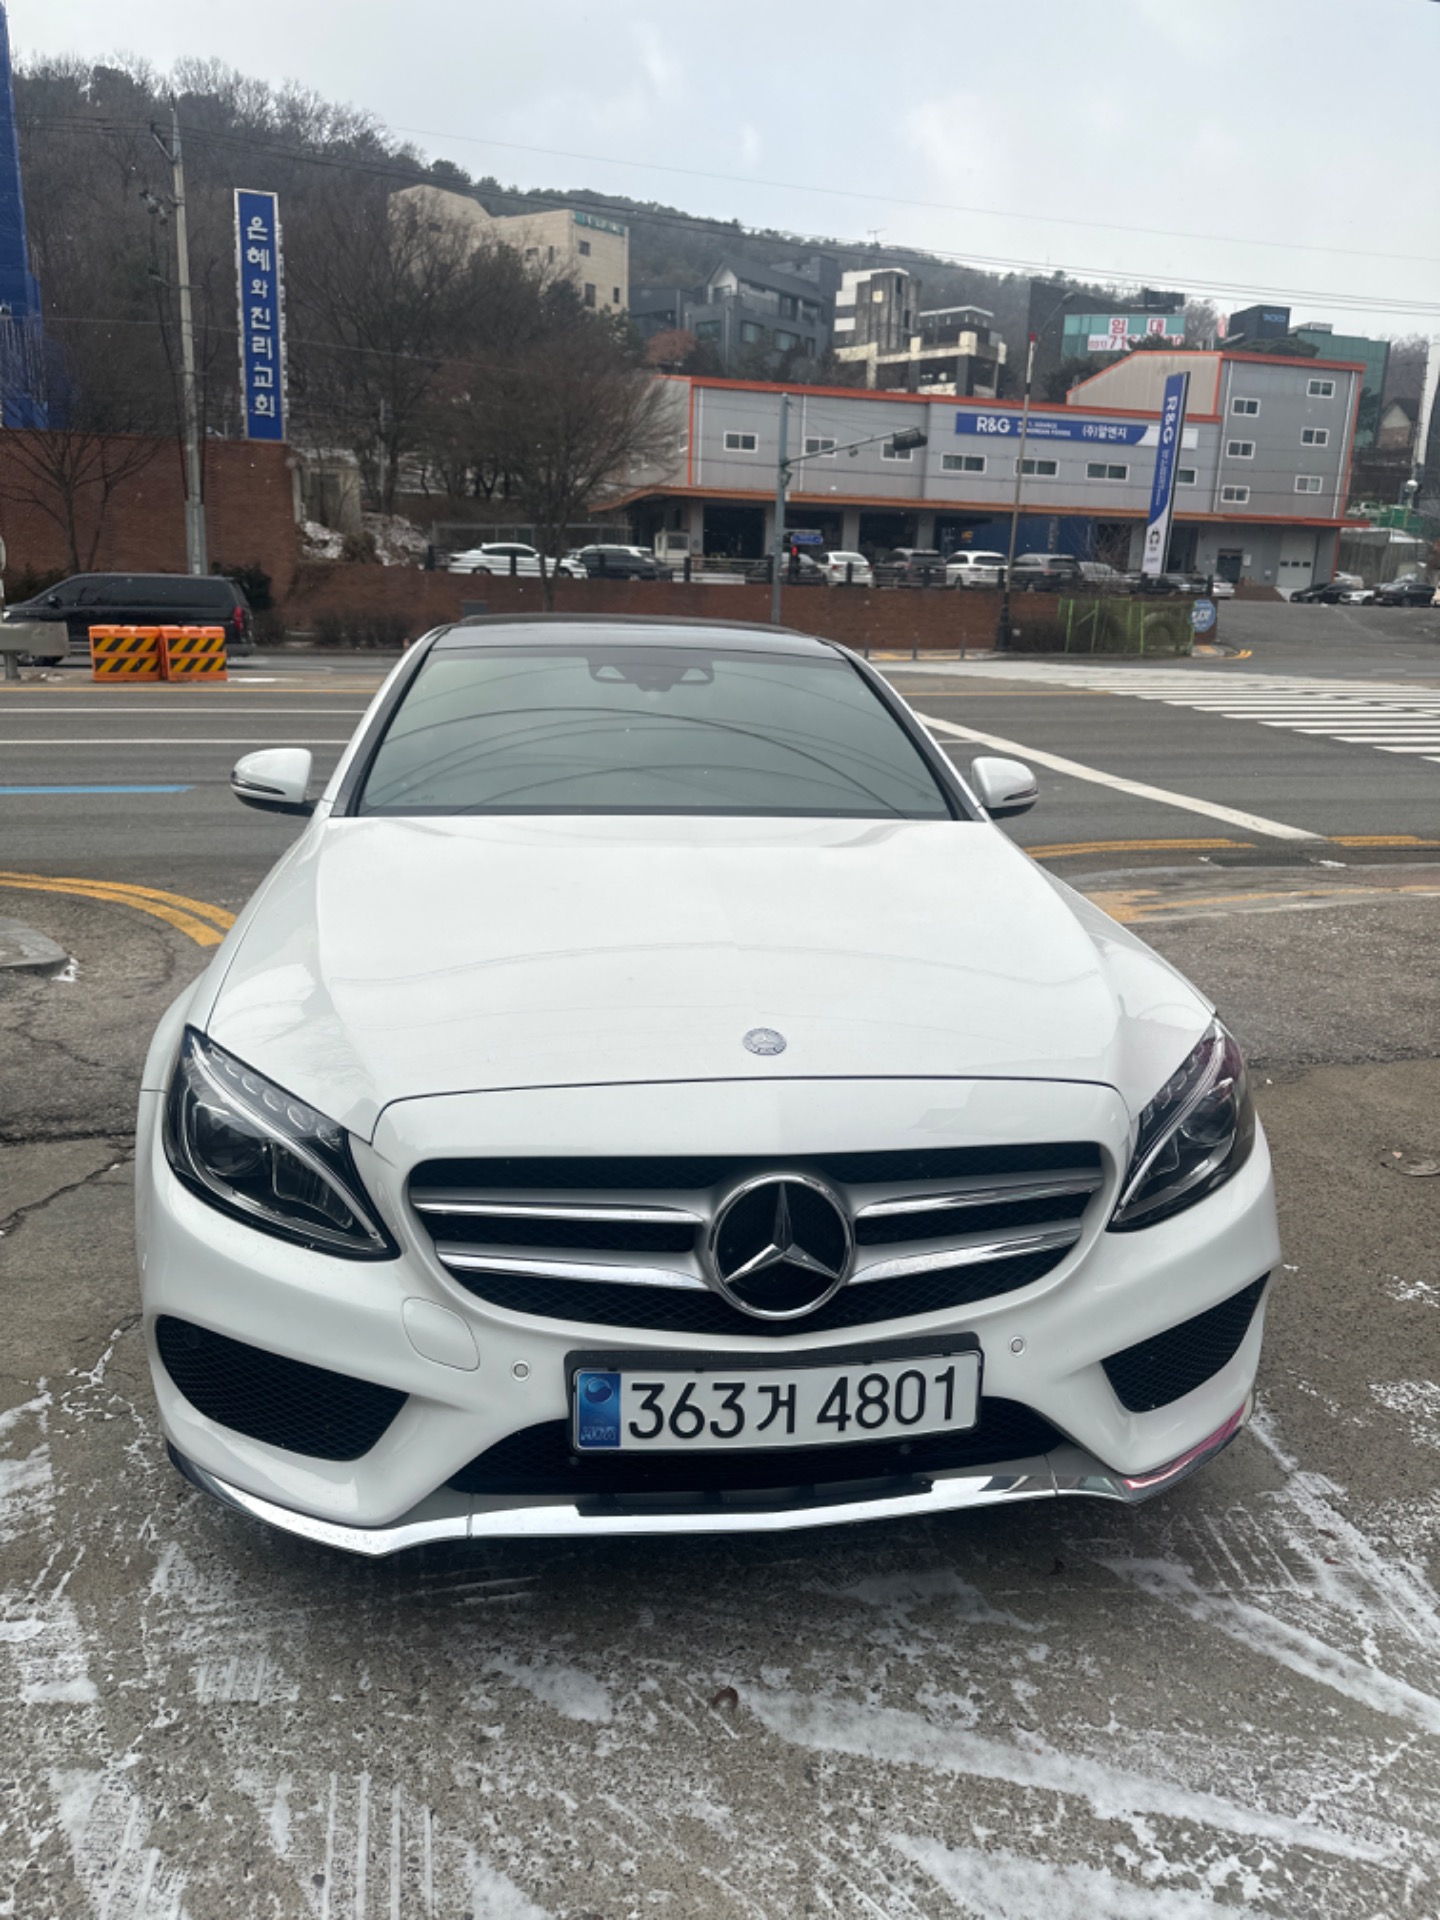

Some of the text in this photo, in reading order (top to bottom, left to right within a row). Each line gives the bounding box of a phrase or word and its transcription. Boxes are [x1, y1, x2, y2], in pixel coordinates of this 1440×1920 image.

[976, 416, 1011, 434] R&G
[1163, 395, 1179, 445] R&G
[628, 1365, 956, 1440] 363거 4801
